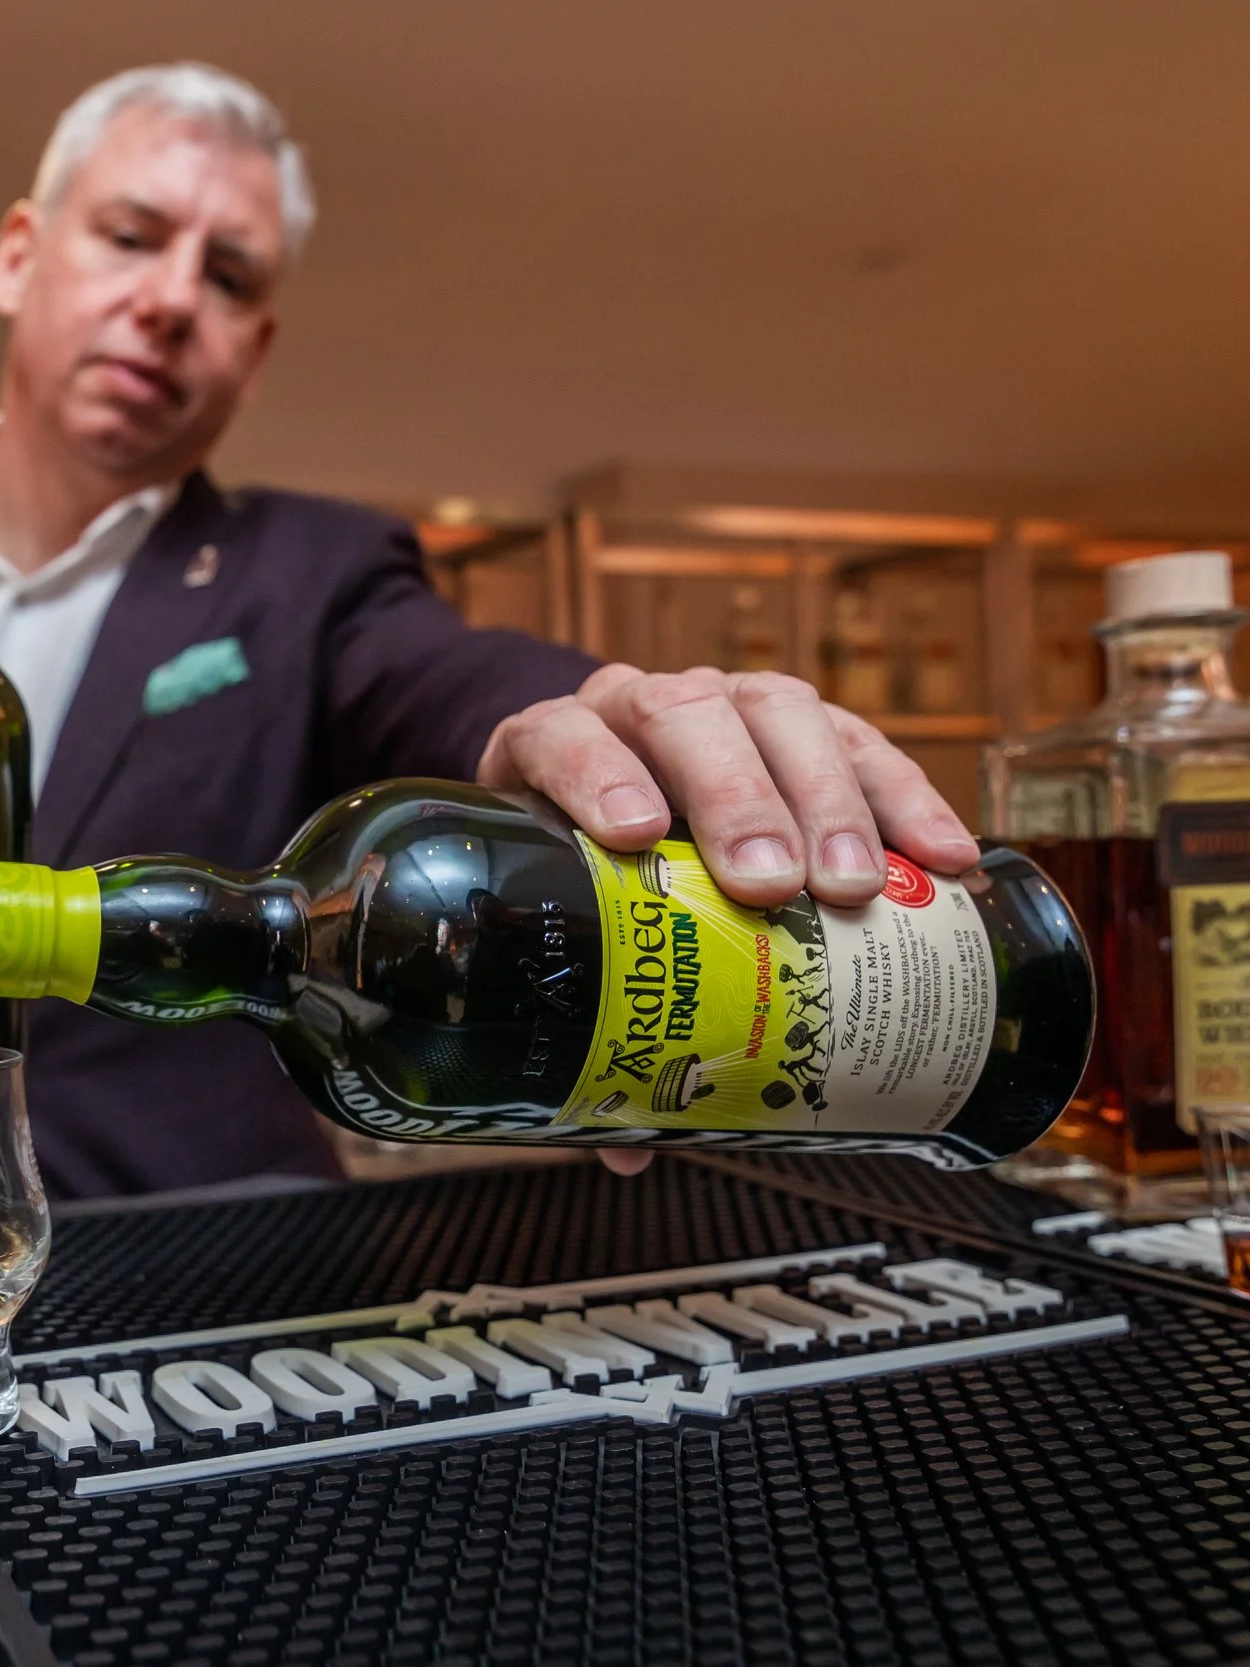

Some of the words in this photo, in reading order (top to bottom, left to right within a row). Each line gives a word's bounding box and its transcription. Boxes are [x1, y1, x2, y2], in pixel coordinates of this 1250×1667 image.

[541, 900, 566, 958] 1815
[894, 918, 903, 934] and
[902, 913, 911, 927] the
[906, 929, 913, 938] to
[863, 927, 877, 969] MALT
[898, 937, 910, 996] WASHBACKS
[908, 940, 920, 974] Ardbeg
[954, 929, 968, 972] LIMITED
[972, 931, 987, 977] SCOTLAND
[664, 911, 701, 1041] FERMUTATION
[755, 934, 771, 1004] WASHBACKS!
[846, 954, 862, 1025] Ultimate
[879, 942, 892, 1003] WHISKY
[980, 979, 988, 989] IN
[595, 901, 668, 1083] Ardbeg
[754, 1004, 761, 1013] OF
[762, 1003, 771, 1014] THE
[865, 975, 878, 1031] SINGLE
[901, 999, 910, 1014] the
[912, 975, 922, 1018] Exposing
[958, 978, 969, 1040] DISTILLERY
[978, 992, 988, 1033] BOTTLED
[744, 1014, 767, 1059] INVASION
[841, 1025, 858, 1050] The
[870, 1010, 890, 1065] SCOTCH
[899, 1016, 909, 1029] off
[905, 1038, 925, 1079] LONGEST
[918, 959, 931, 1036] FERMENTATION
[850, 1036, 871, 1076] ISLAY
[888, 1054, 899, 1068] the
[894, 1031, 905, 1052] LIDS
[942, 1034, 950, 1052] NON
[882, 1069, 894, 1081] lift
[888, 1047, 912, 1094] remarkable
[922, 1058, 929, 1067] or
[943, 1045, 963, 1085] ARDBEG
[957, 1062, 966, 1071] OF
[960, 1044, 982, 1086] DISTILLED
[876, 1082, 886, 1094] We
[14, 1258, 1063, 1460] WOODINVILLE
